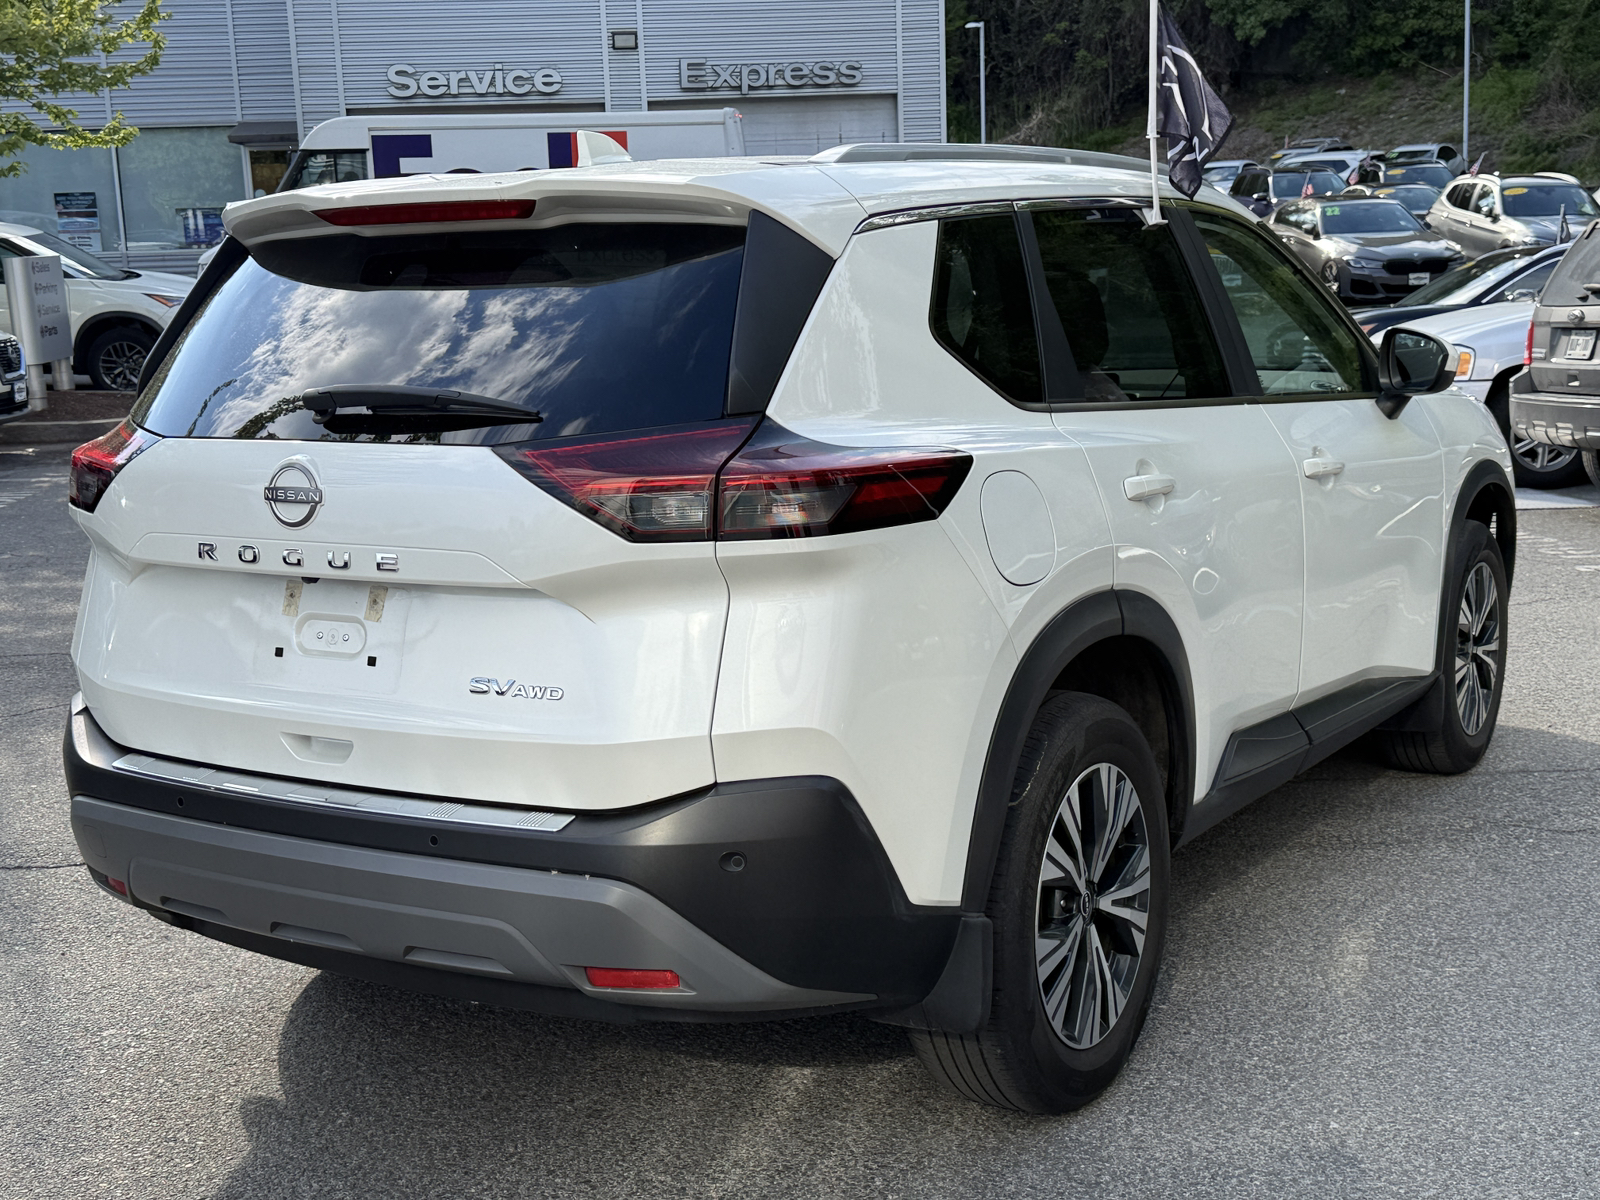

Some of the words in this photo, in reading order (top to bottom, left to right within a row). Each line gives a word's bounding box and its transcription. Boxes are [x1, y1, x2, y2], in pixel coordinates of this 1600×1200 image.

[386, 63, 563, 98] Service
[679, 58, 863, 94] Express
[265, 489, 320, 502] NISSAN
[198, 541, 399, 572] ROGUE
